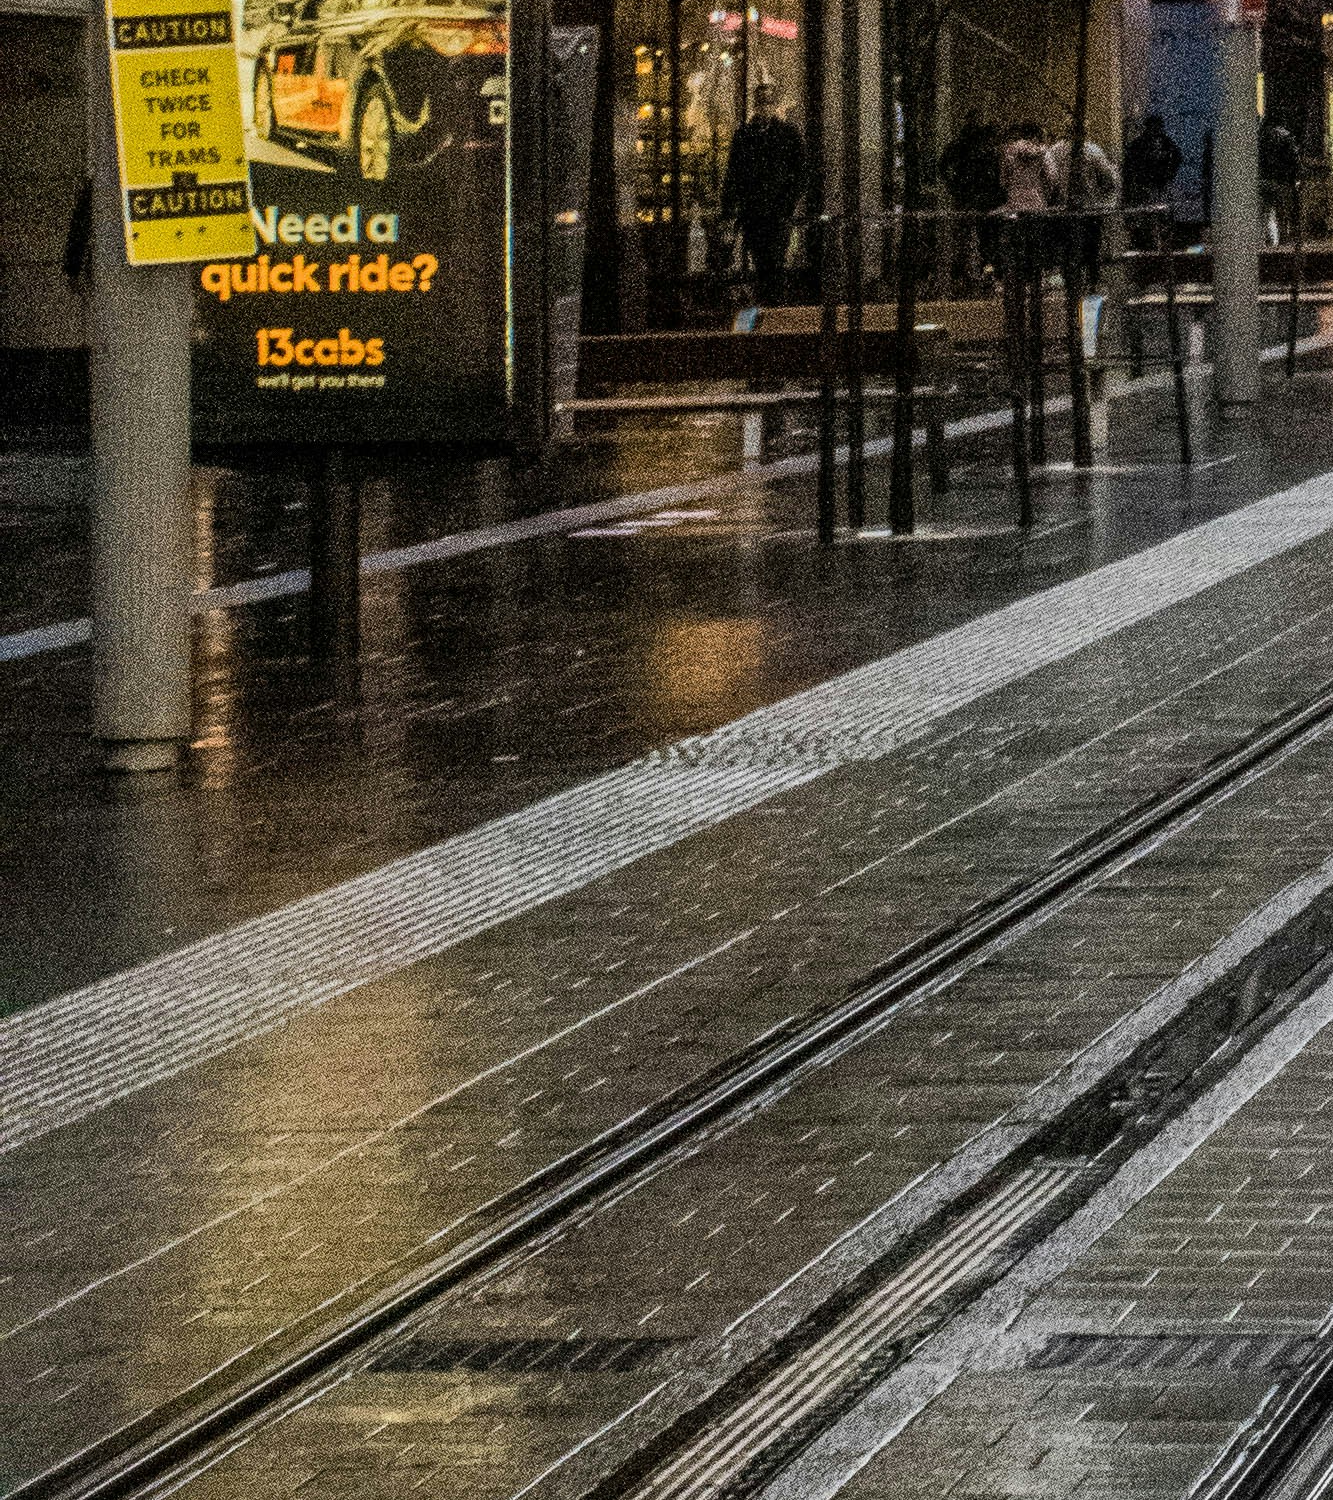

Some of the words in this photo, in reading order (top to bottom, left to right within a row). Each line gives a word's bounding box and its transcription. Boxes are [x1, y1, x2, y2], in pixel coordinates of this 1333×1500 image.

[117, 18, 228, 43] CAUTION
[140, 67, 212, 89] CHECK
[144, 93, 213, 114] TWICE
[160, 121, 201, 140] FOR
[147, 148, 221, 168] TRAMS
[132, 188, 244, 215] CAUTION
[252, 204, 361, 243] Need
[366, 213, 399, 243] a
[200, 253, 321, 302] quick
[328, 253, 440, 294] ride?
[256, 327, 385, 367] 13cabs
